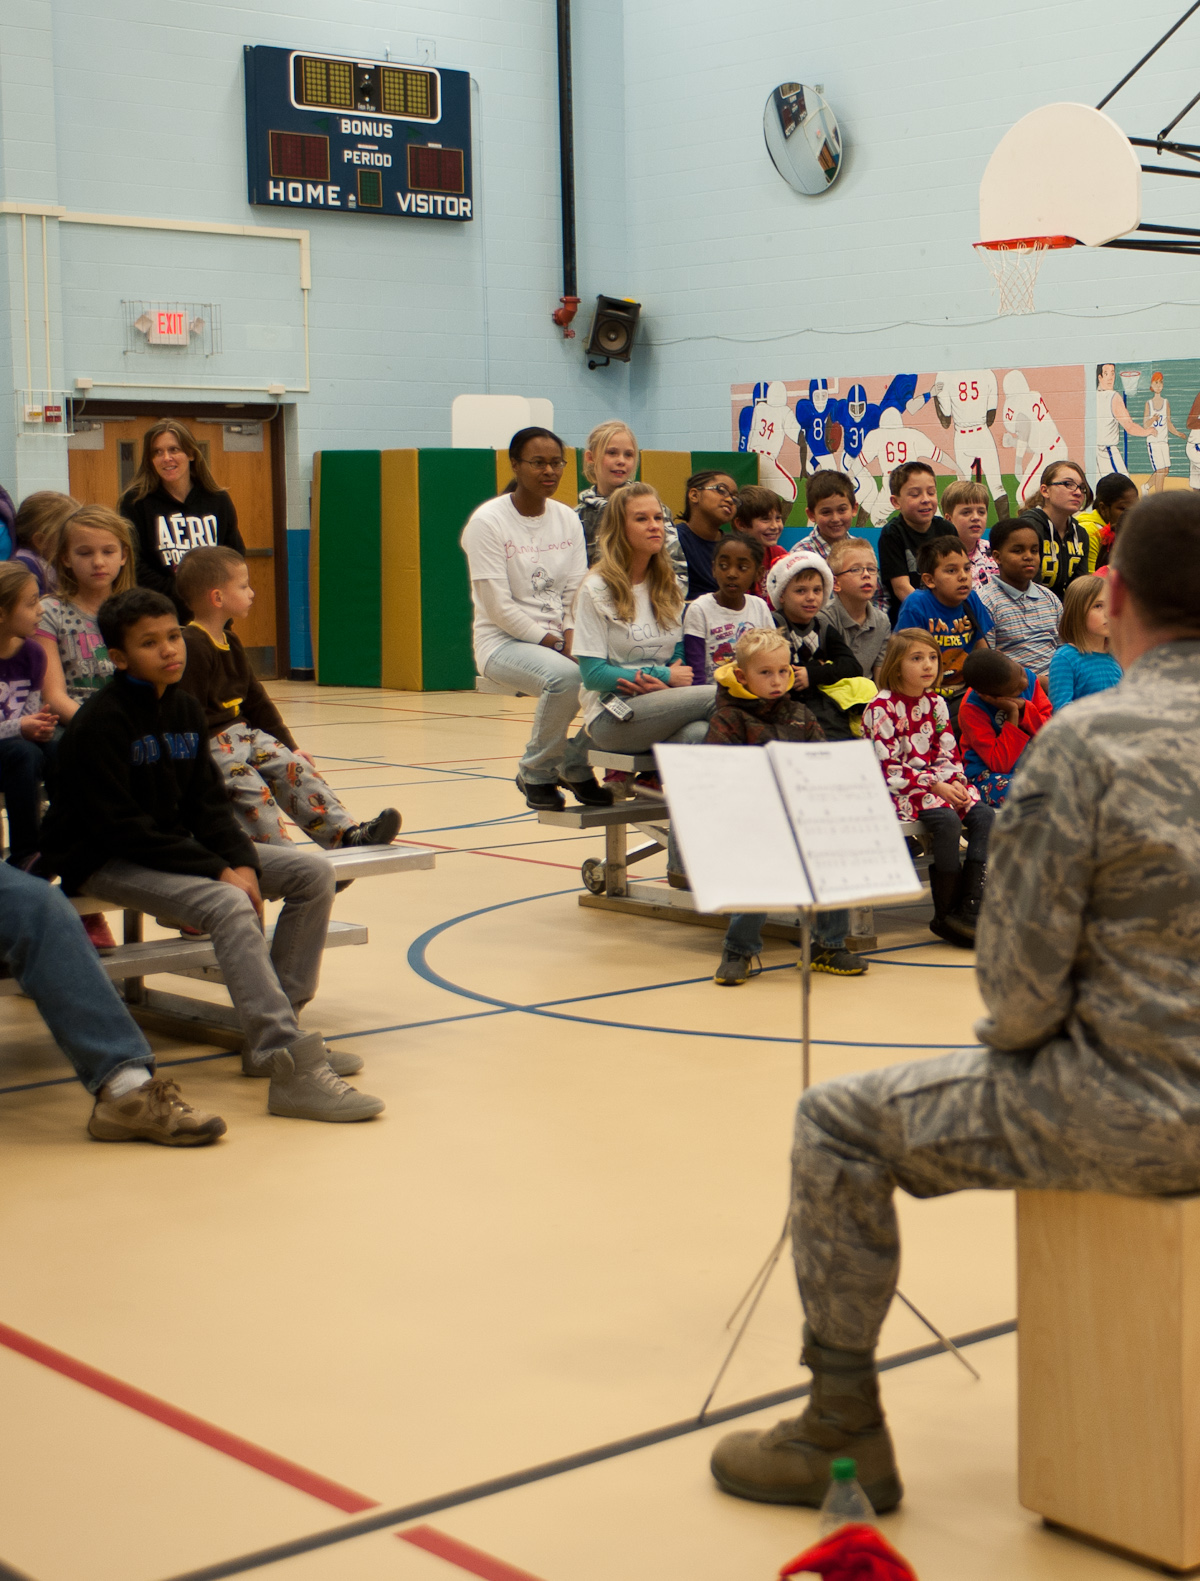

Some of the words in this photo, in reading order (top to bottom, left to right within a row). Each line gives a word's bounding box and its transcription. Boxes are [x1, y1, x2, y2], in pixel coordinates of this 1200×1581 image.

[341, 118, 393, 139] BONUS
[343, 149, 393, 168] PERIOD
[268, 180, 342, 207] HOME
[396, 191, 472, 218] VISITOR
[157, 312, 184, 335] EXIT
[958, 381, 979, 401] 85
[1005, 407, 1015, 421] 21
[1032, 397, 1049, 421] 21
[759, 418, 774, 440] 34
[849, 427, 865, 448] 31
[885, 442, 907, 463] 69
[928, 617, 949, 634] I'M
[950, 615, 973, 634] JUS
